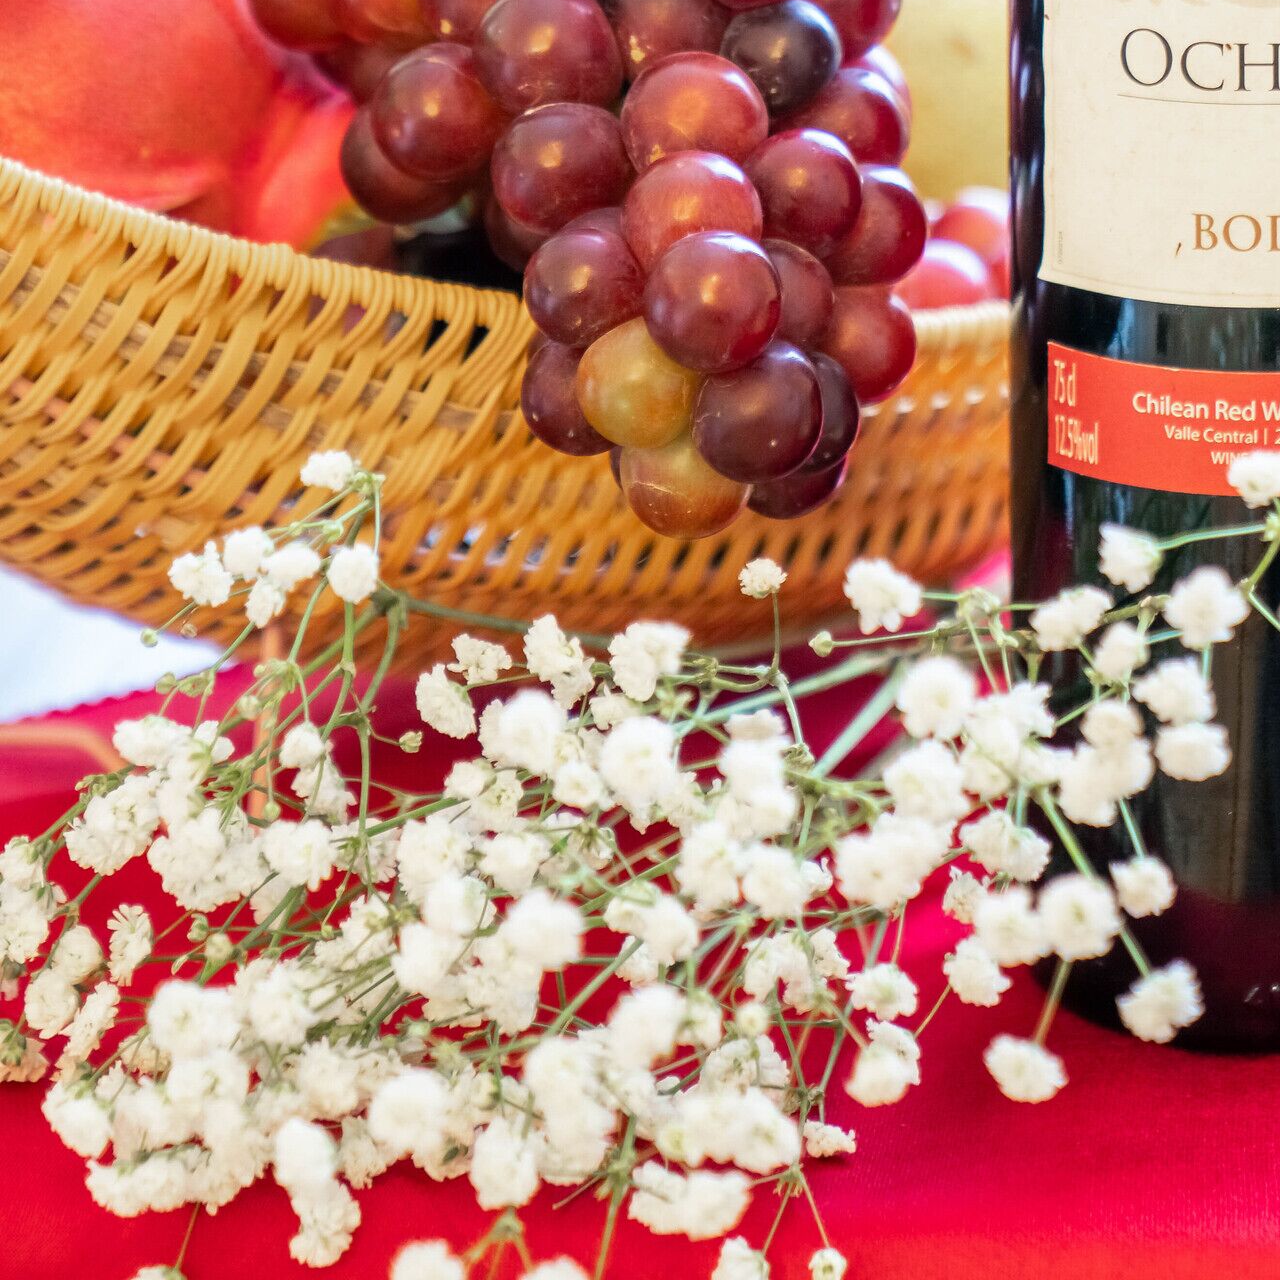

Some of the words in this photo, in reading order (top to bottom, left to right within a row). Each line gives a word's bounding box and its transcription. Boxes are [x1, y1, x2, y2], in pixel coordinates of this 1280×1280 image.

[1132, 391, 1209, 420] Chilean
[1215, 399, 1257, 422] Red
[1164, 425, 1200, 441] Valle
[1203, 428, 1257, 445] Central
